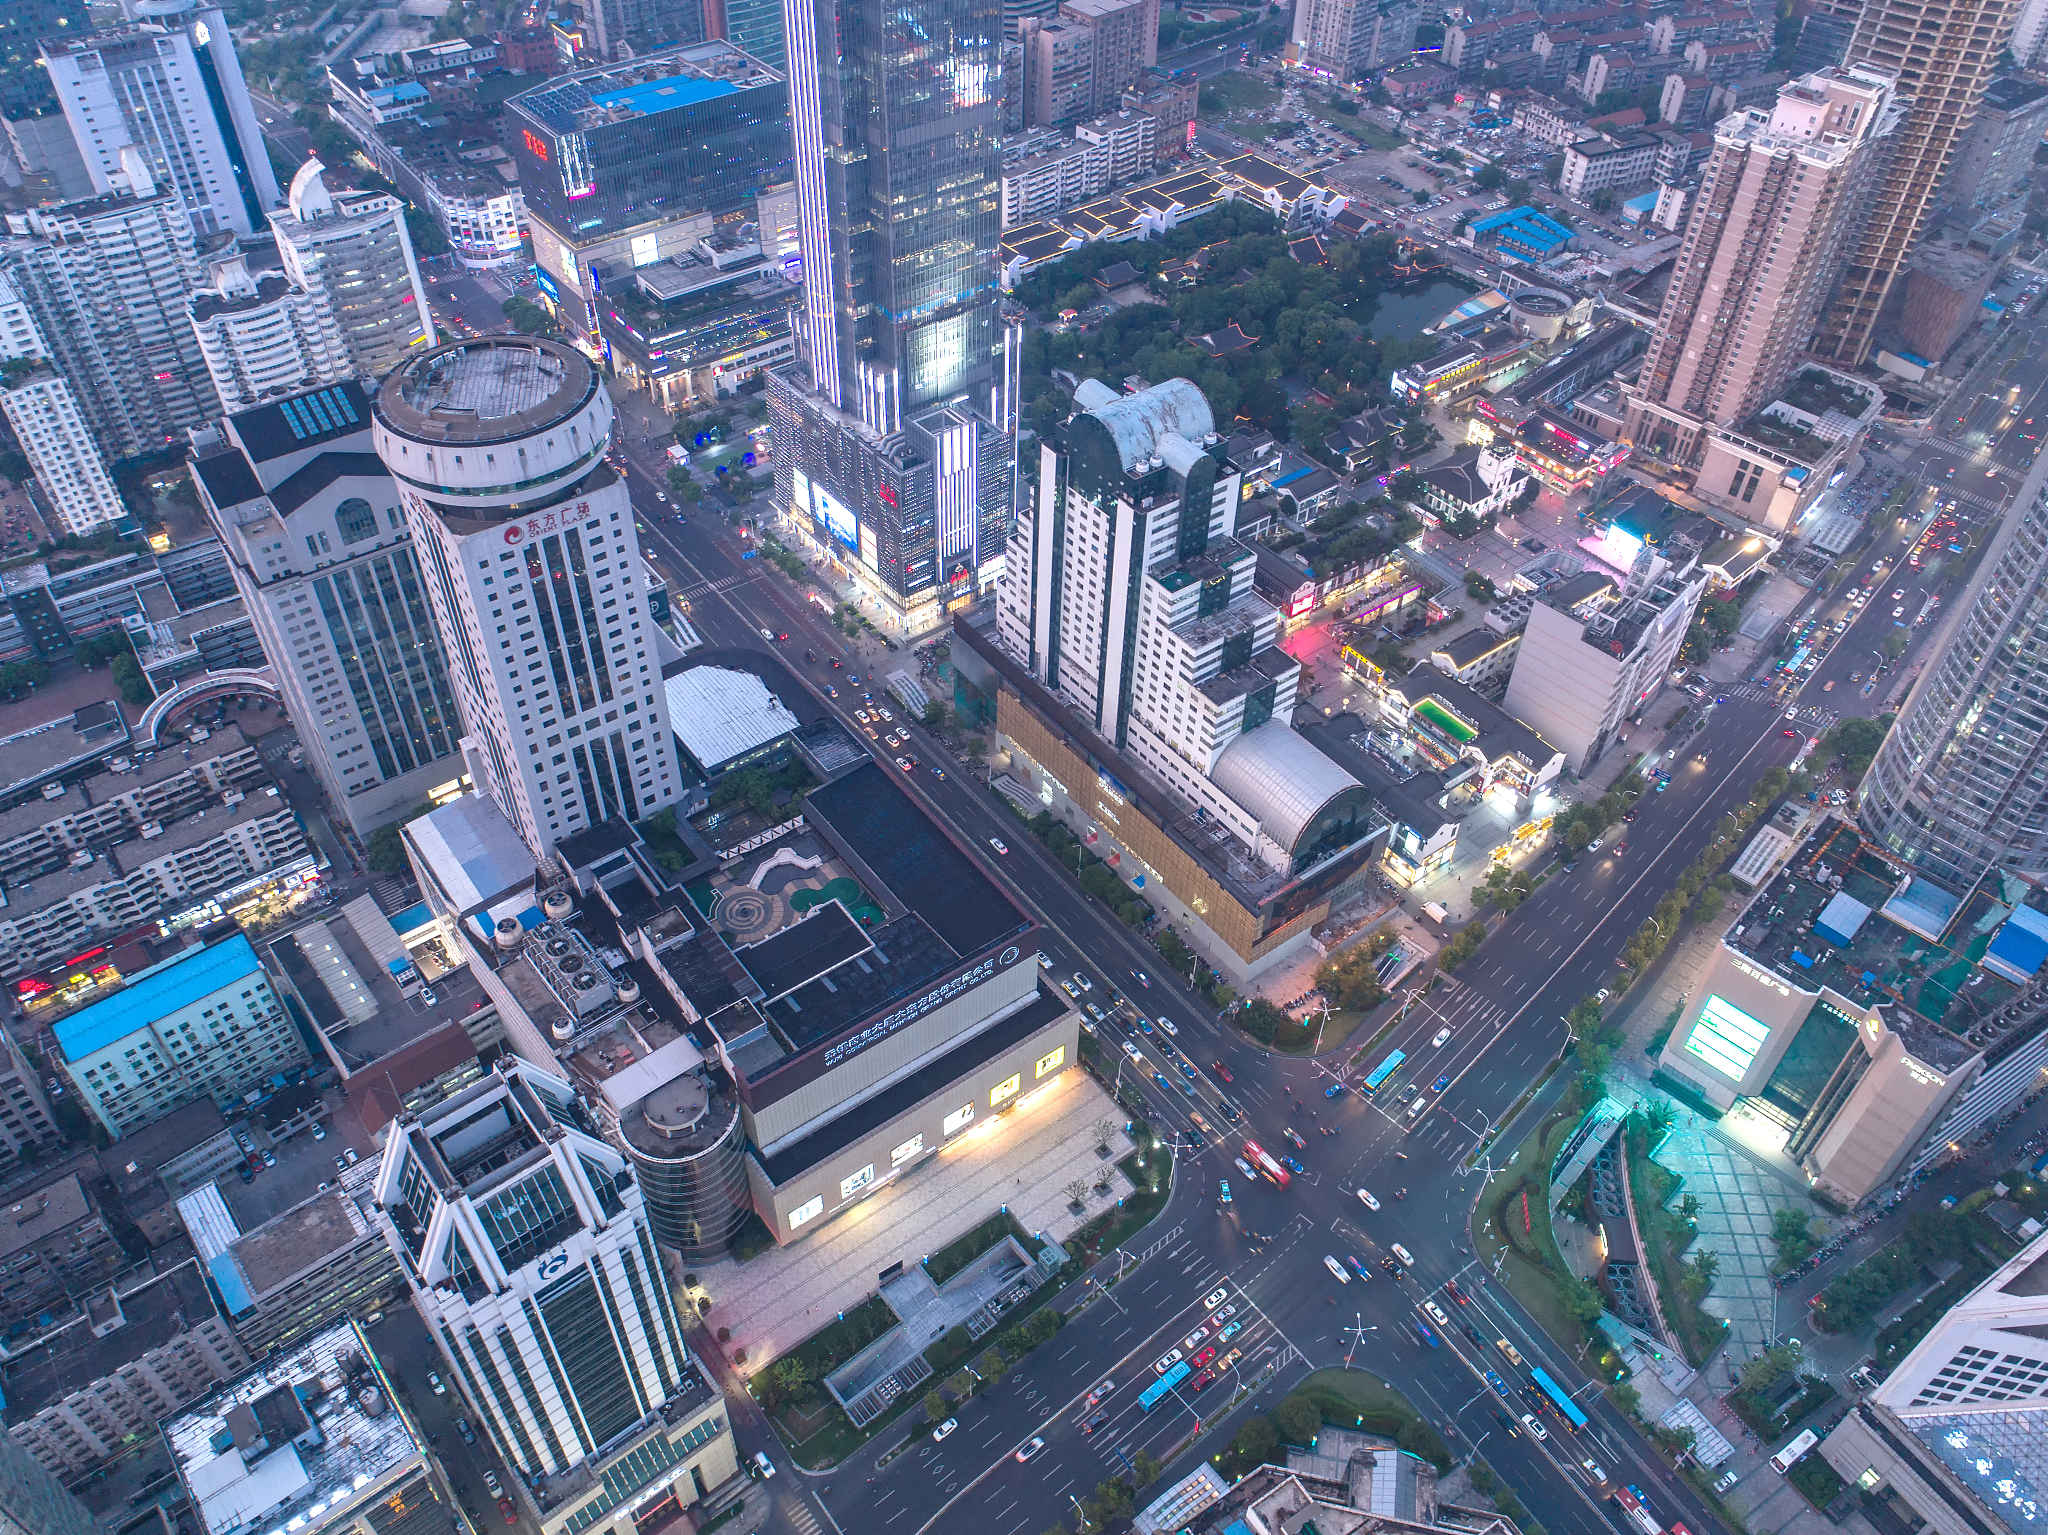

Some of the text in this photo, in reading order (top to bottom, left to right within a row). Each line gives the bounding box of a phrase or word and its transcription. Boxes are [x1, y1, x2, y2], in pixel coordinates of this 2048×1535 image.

[526, 501, 591, 534] 东方广场
[529, 512, 591, 538] ORIENT PLAZA
[1900, 1056, 1946, 1087] PARKSON
